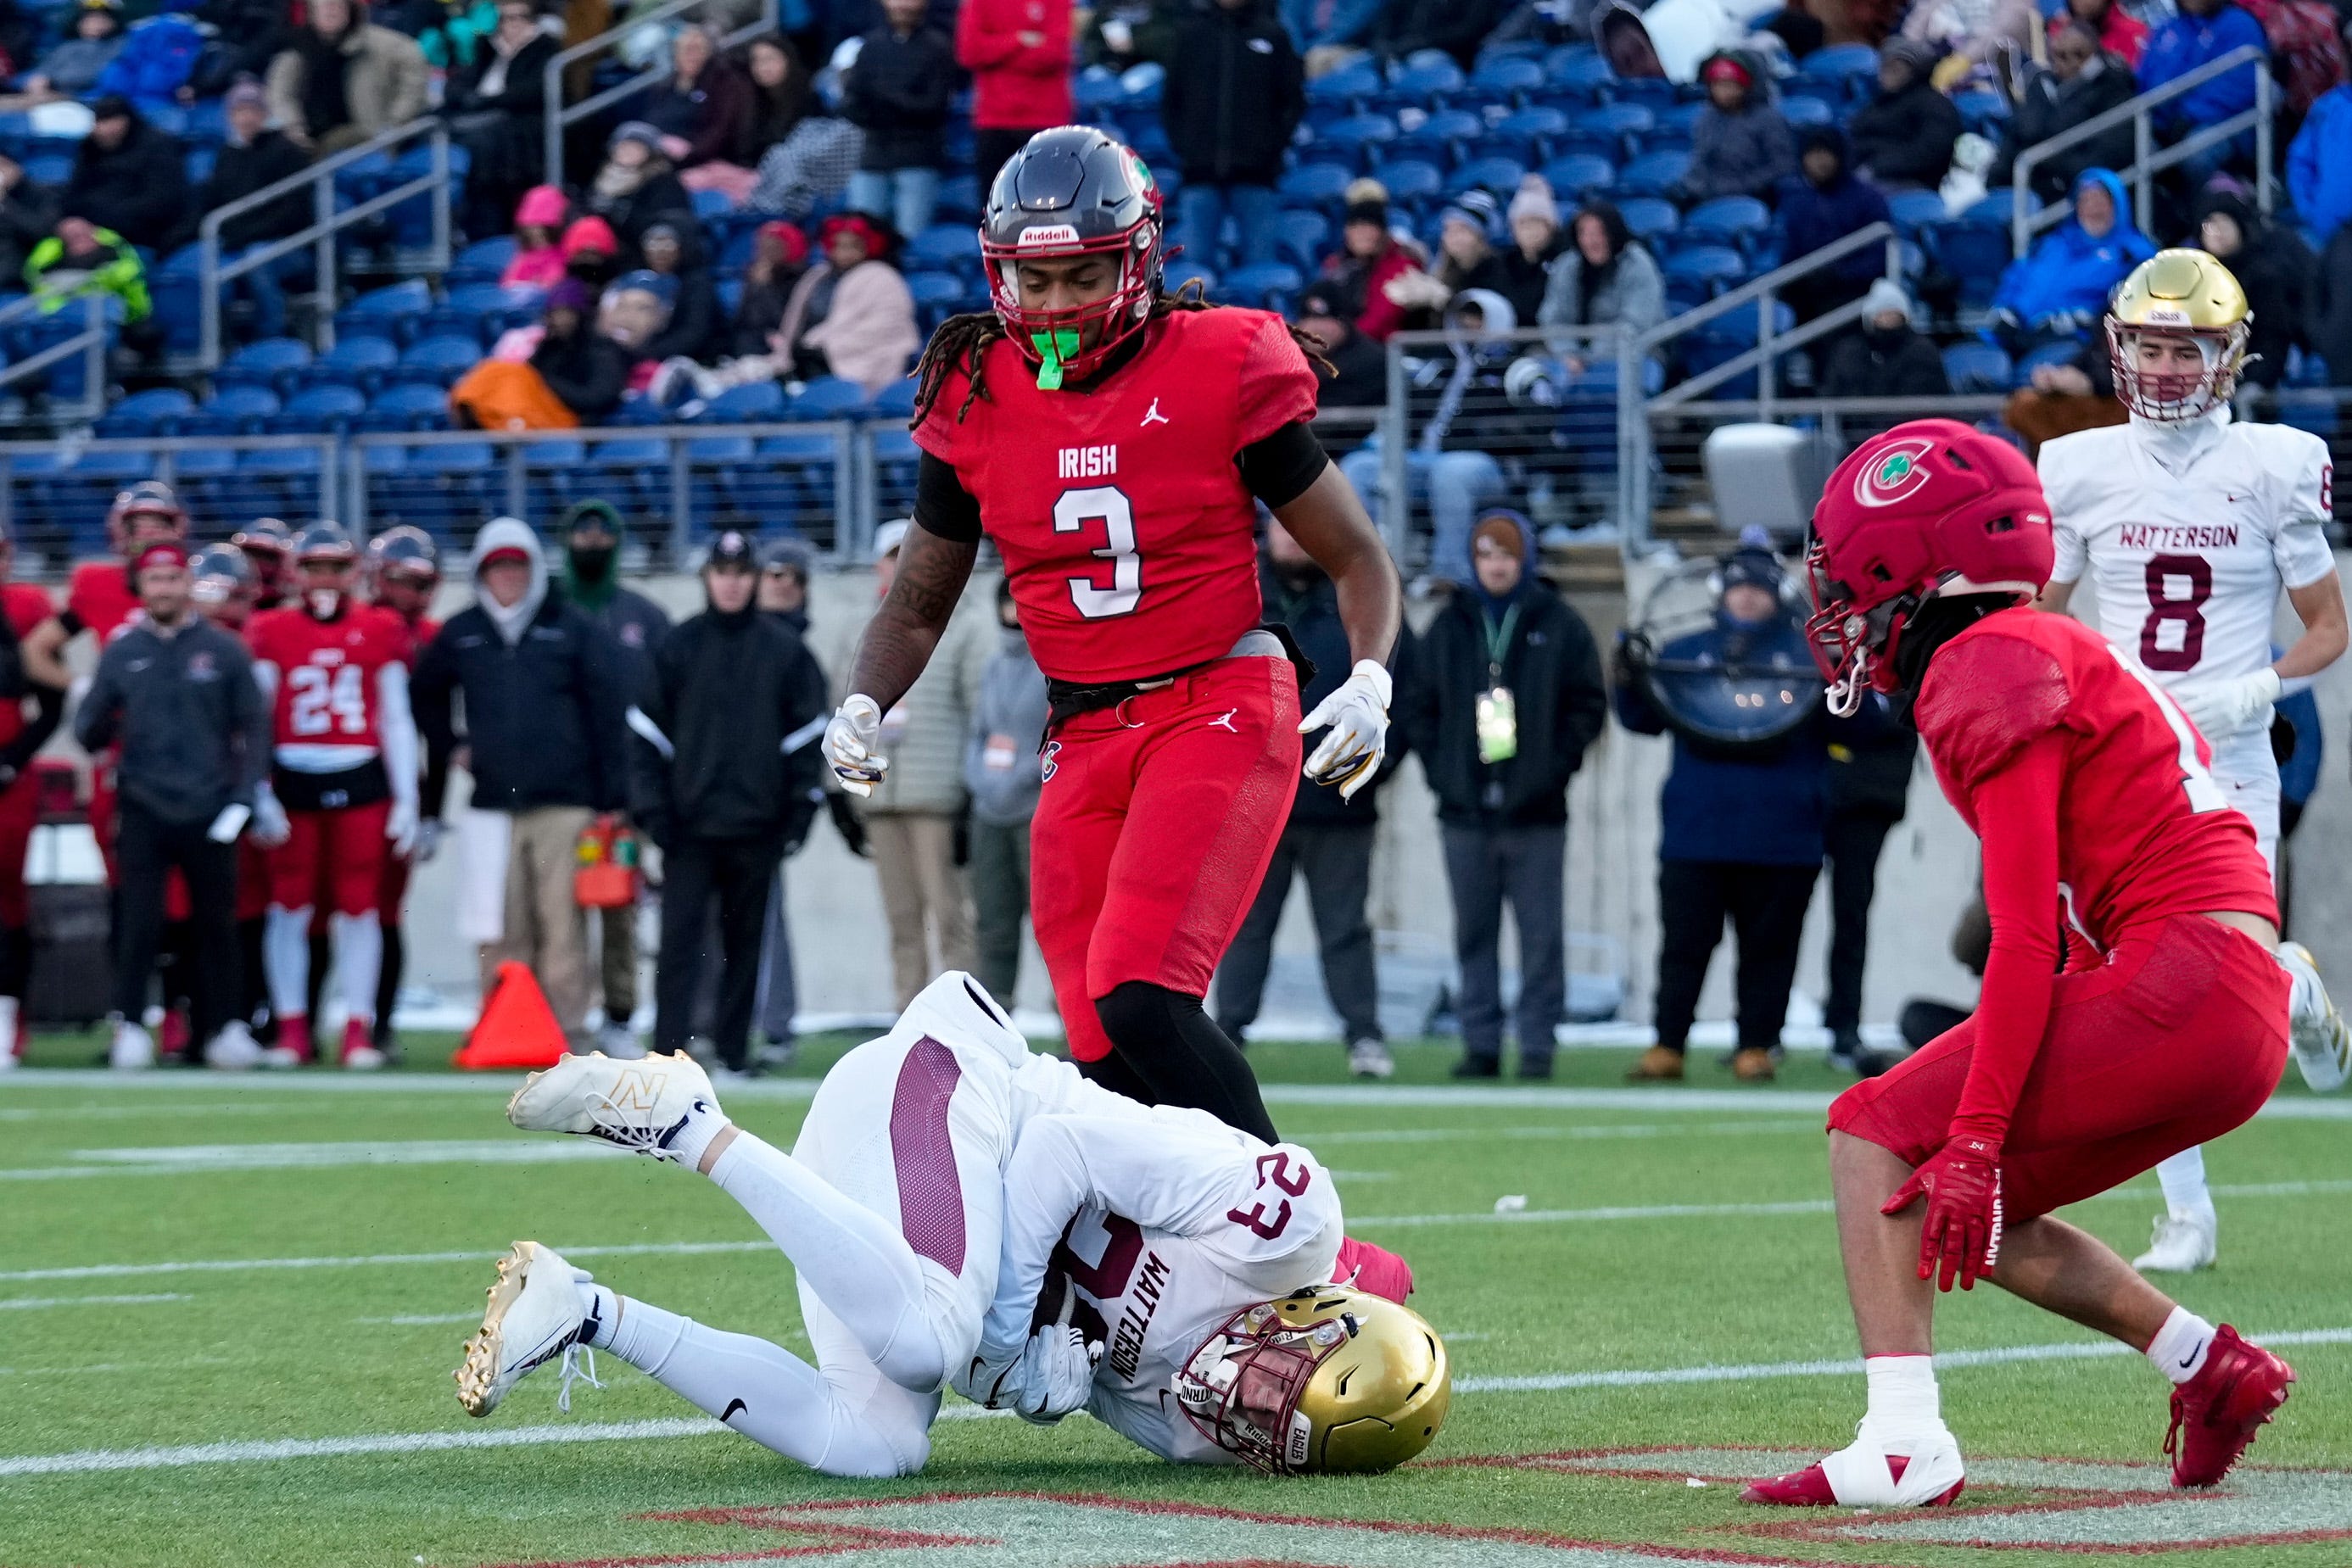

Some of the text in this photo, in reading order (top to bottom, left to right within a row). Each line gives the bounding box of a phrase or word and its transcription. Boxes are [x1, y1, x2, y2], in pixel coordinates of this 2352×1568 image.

[1024, 229, 1070, 243] Riddell
[1059, 444, 1117, 478] IRISH
[1052, 484, 1142, 620] 3
[2120, 523, 2238, 550] WATTERSON
[2139, 552, 2213, 672] 8
[288, 664, 367, 736] 24
[1226, 1152, 1311, 1241] 23
[1109, 1250, 1170, 1385] WATTERSON
[1291, 1427, 1307, 1461] EAGLES
